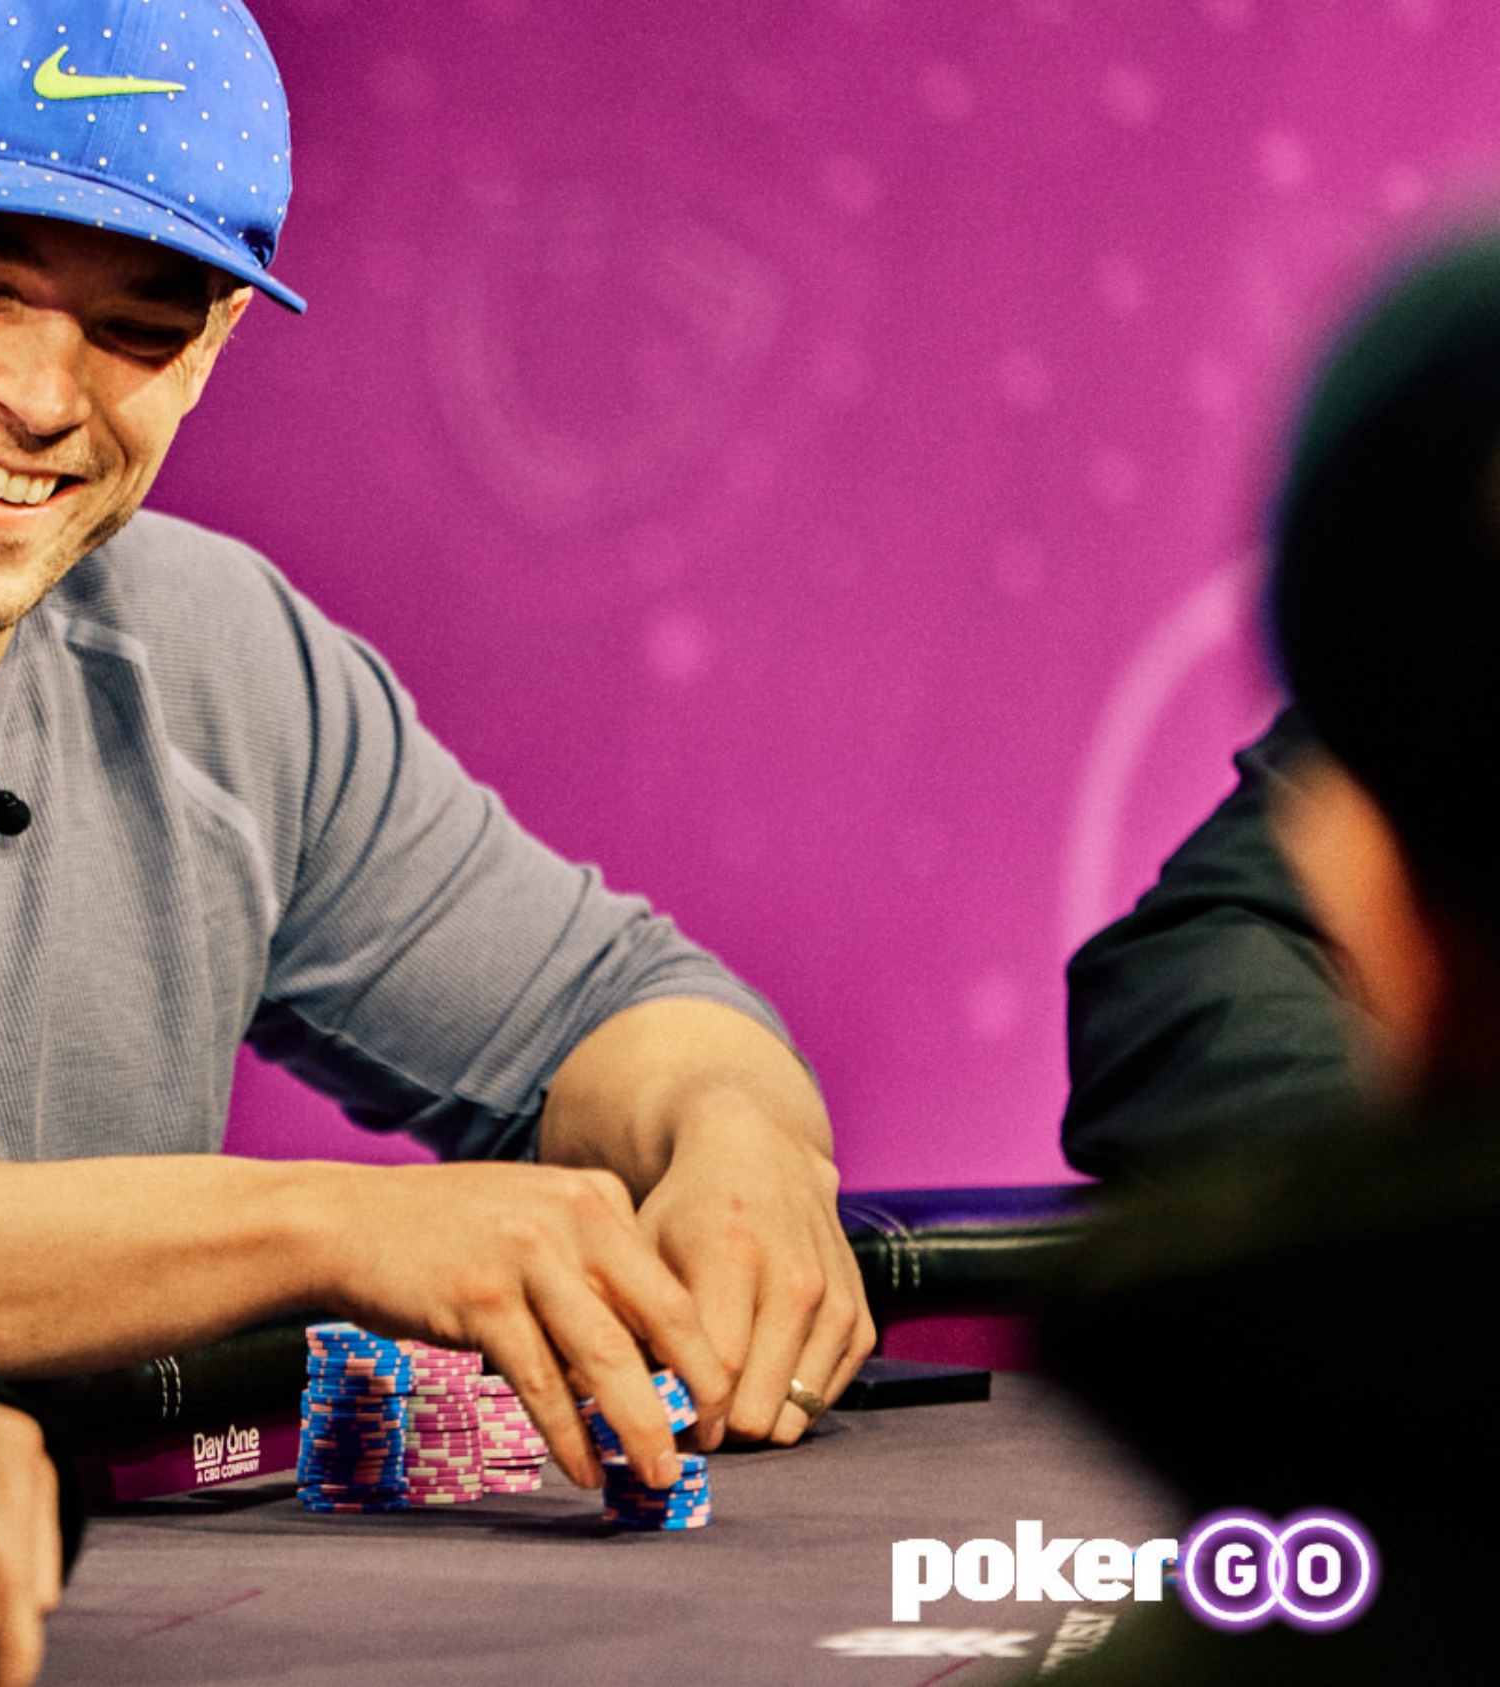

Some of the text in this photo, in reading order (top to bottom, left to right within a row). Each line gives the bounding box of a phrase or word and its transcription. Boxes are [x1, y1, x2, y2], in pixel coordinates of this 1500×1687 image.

[193, 1423, 260, 1465] Day One
[196, 1470, 203, 1484] A
[221, 1458, 260, 1479] COMPANY
